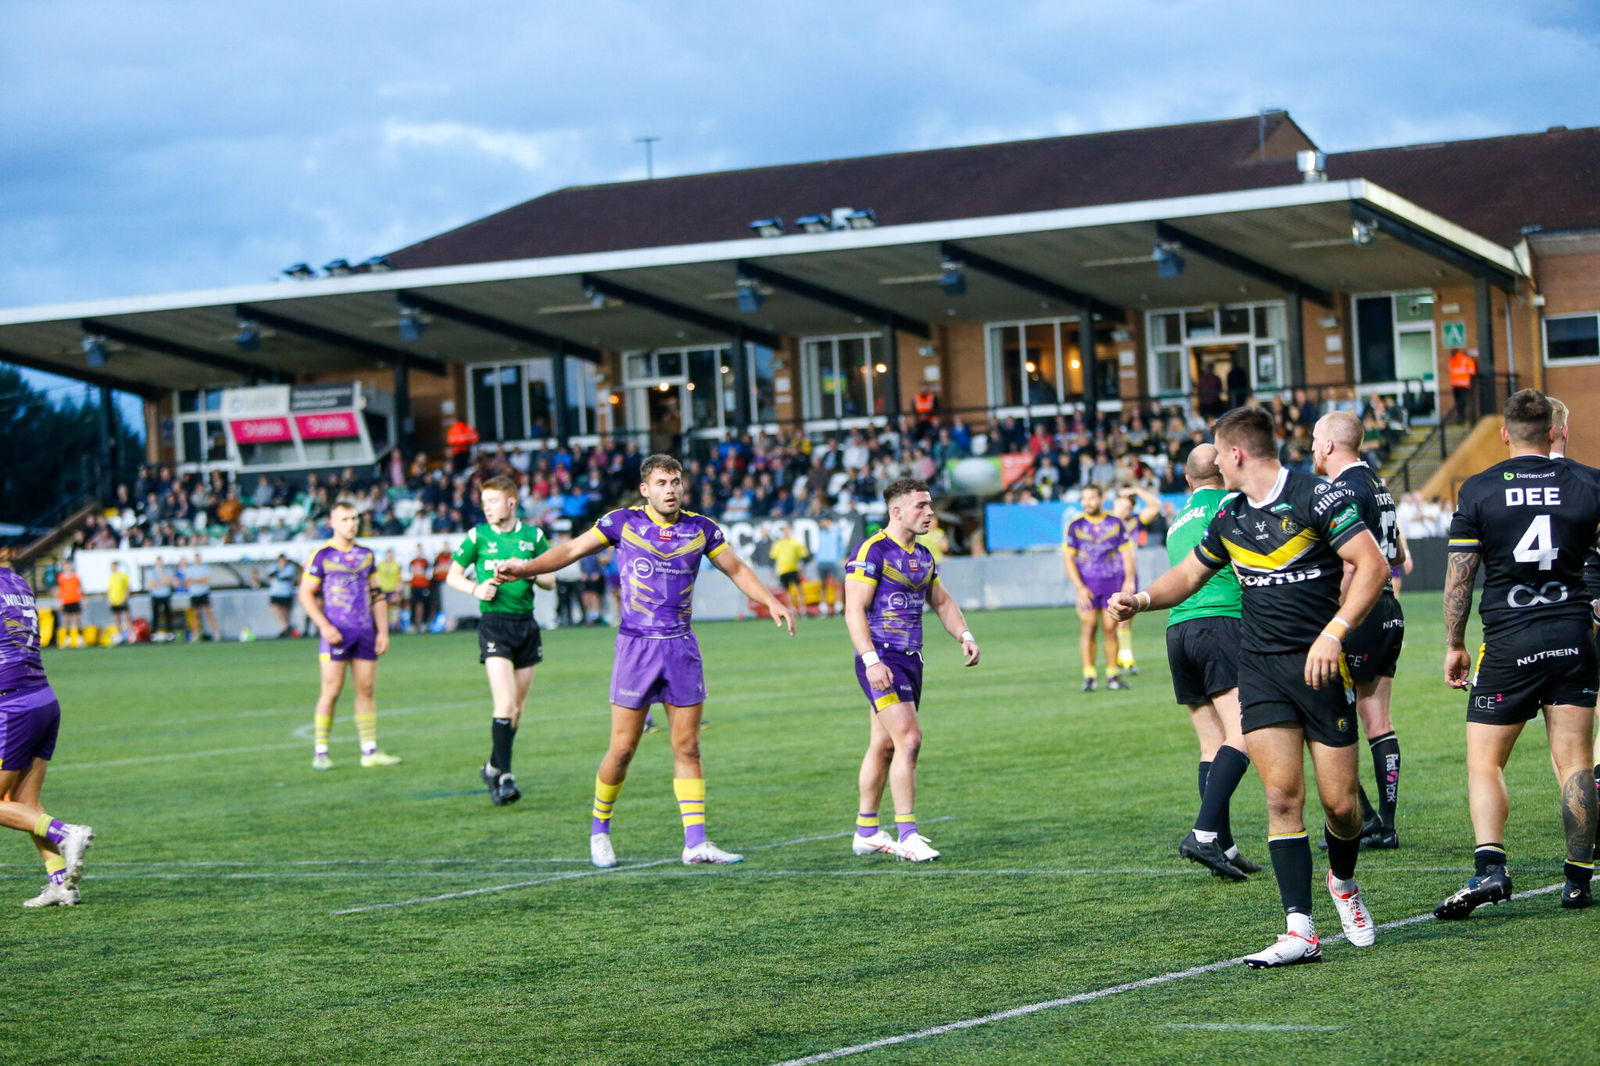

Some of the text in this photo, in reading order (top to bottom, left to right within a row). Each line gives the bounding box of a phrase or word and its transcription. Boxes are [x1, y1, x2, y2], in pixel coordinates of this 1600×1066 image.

[1516, 471, 1556, 479] bartercard
[1505, 487, 1561, 507] DEE
[1512, 514, 1560, 571] 4
[22, 609, 38, 647] 7
[1517, 647, 1579, 667] NUTREIN
